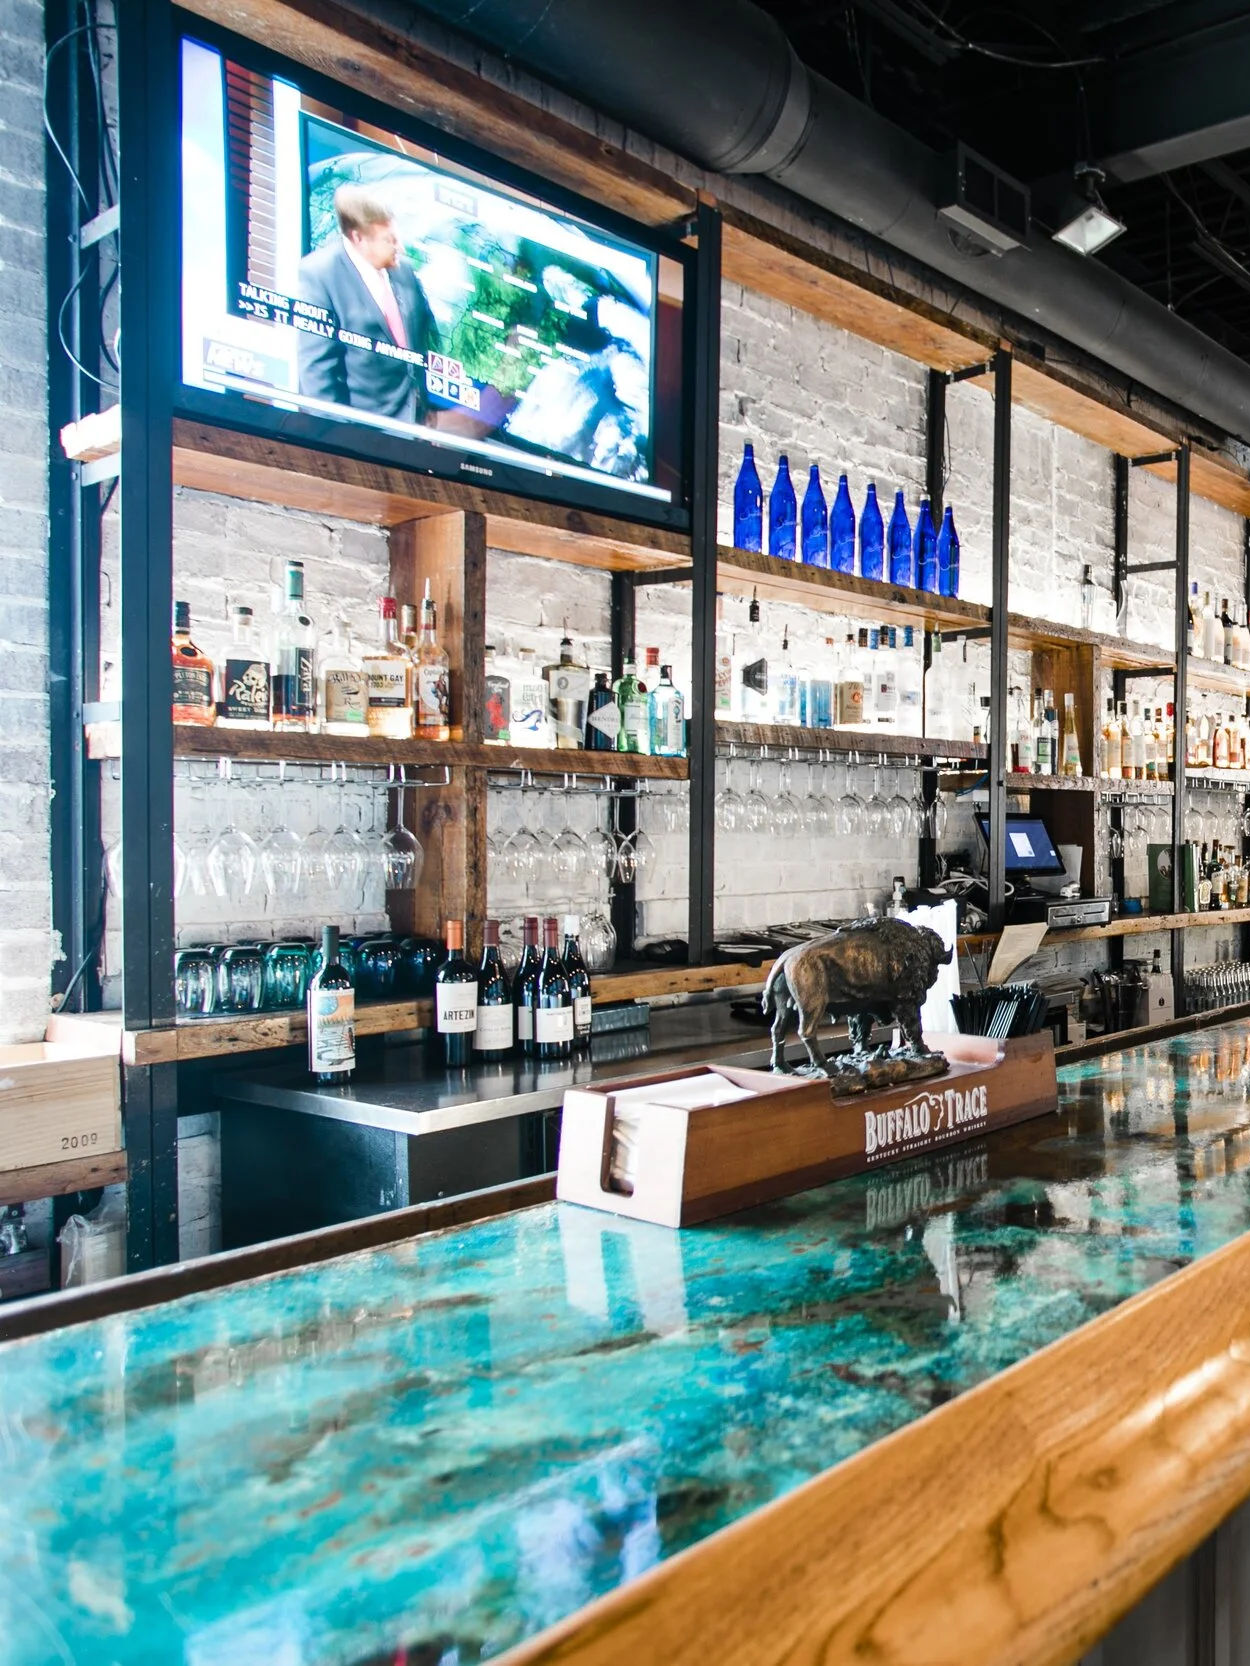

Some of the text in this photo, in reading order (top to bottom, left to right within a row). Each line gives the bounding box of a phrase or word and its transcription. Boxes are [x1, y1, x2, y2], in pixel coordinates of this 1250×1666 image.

[239, 282, 333, 324] TALKING ABOUT.
[274, 308, 289, 324] IT
[293, 315, 335, 338] REALLY
[338, 329, 372, 351] GOING
[375, 341, 428, 368] ANYWHERE.
[460, 463, 493, 477] SAMSUNG
[390, 674, 404, 682] GAY
[443, 1009, 474, 1021] ARTEZIN
[864, 1085, 988, 1155] BUFFALO TRACE
[61, 1132, 98, 1150] 2009
[866, 1121, 987, 1163] KENTUCKY STRAIGHT BOURBON WHISKEY
